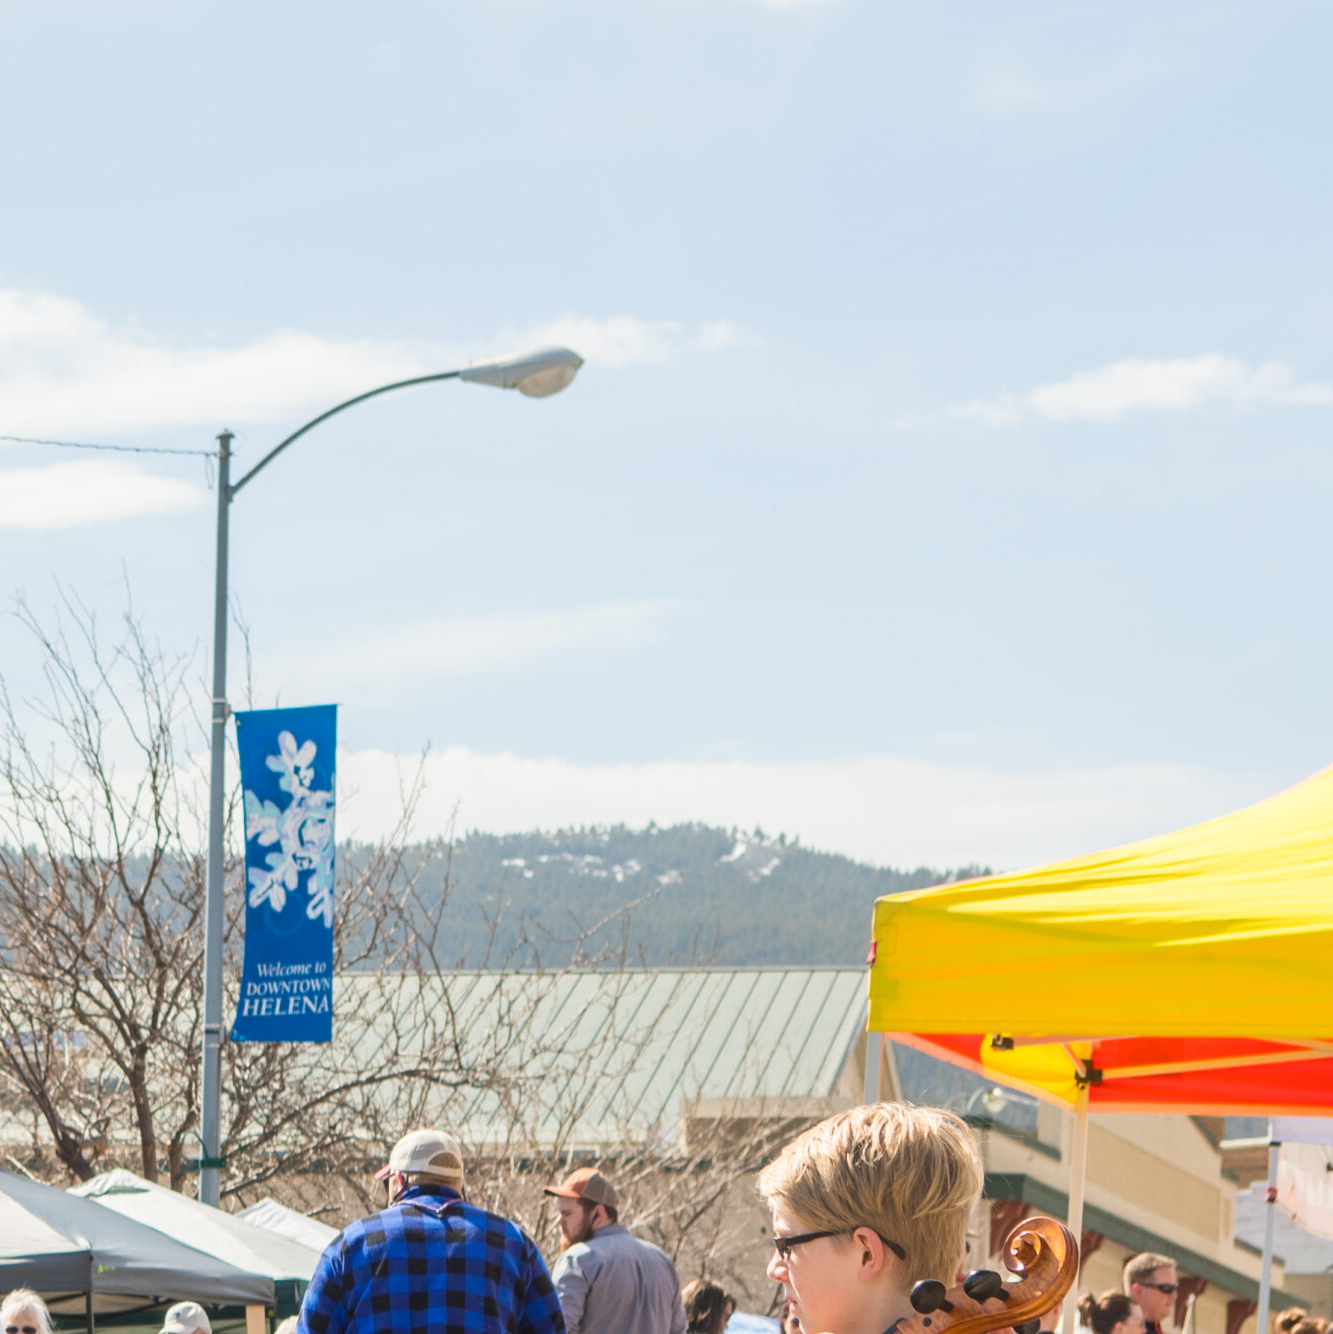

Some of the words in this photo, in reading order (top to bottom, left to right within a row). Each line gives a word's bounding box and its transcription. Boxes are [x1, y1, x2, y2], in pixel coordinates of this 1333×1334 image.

[257, 961, 312, 978] Welcome
[314, 961, 327, 974] to
[246, 977, 330, 996] DOWNTOWN
[242, 995, 329, 1016] HELENA
